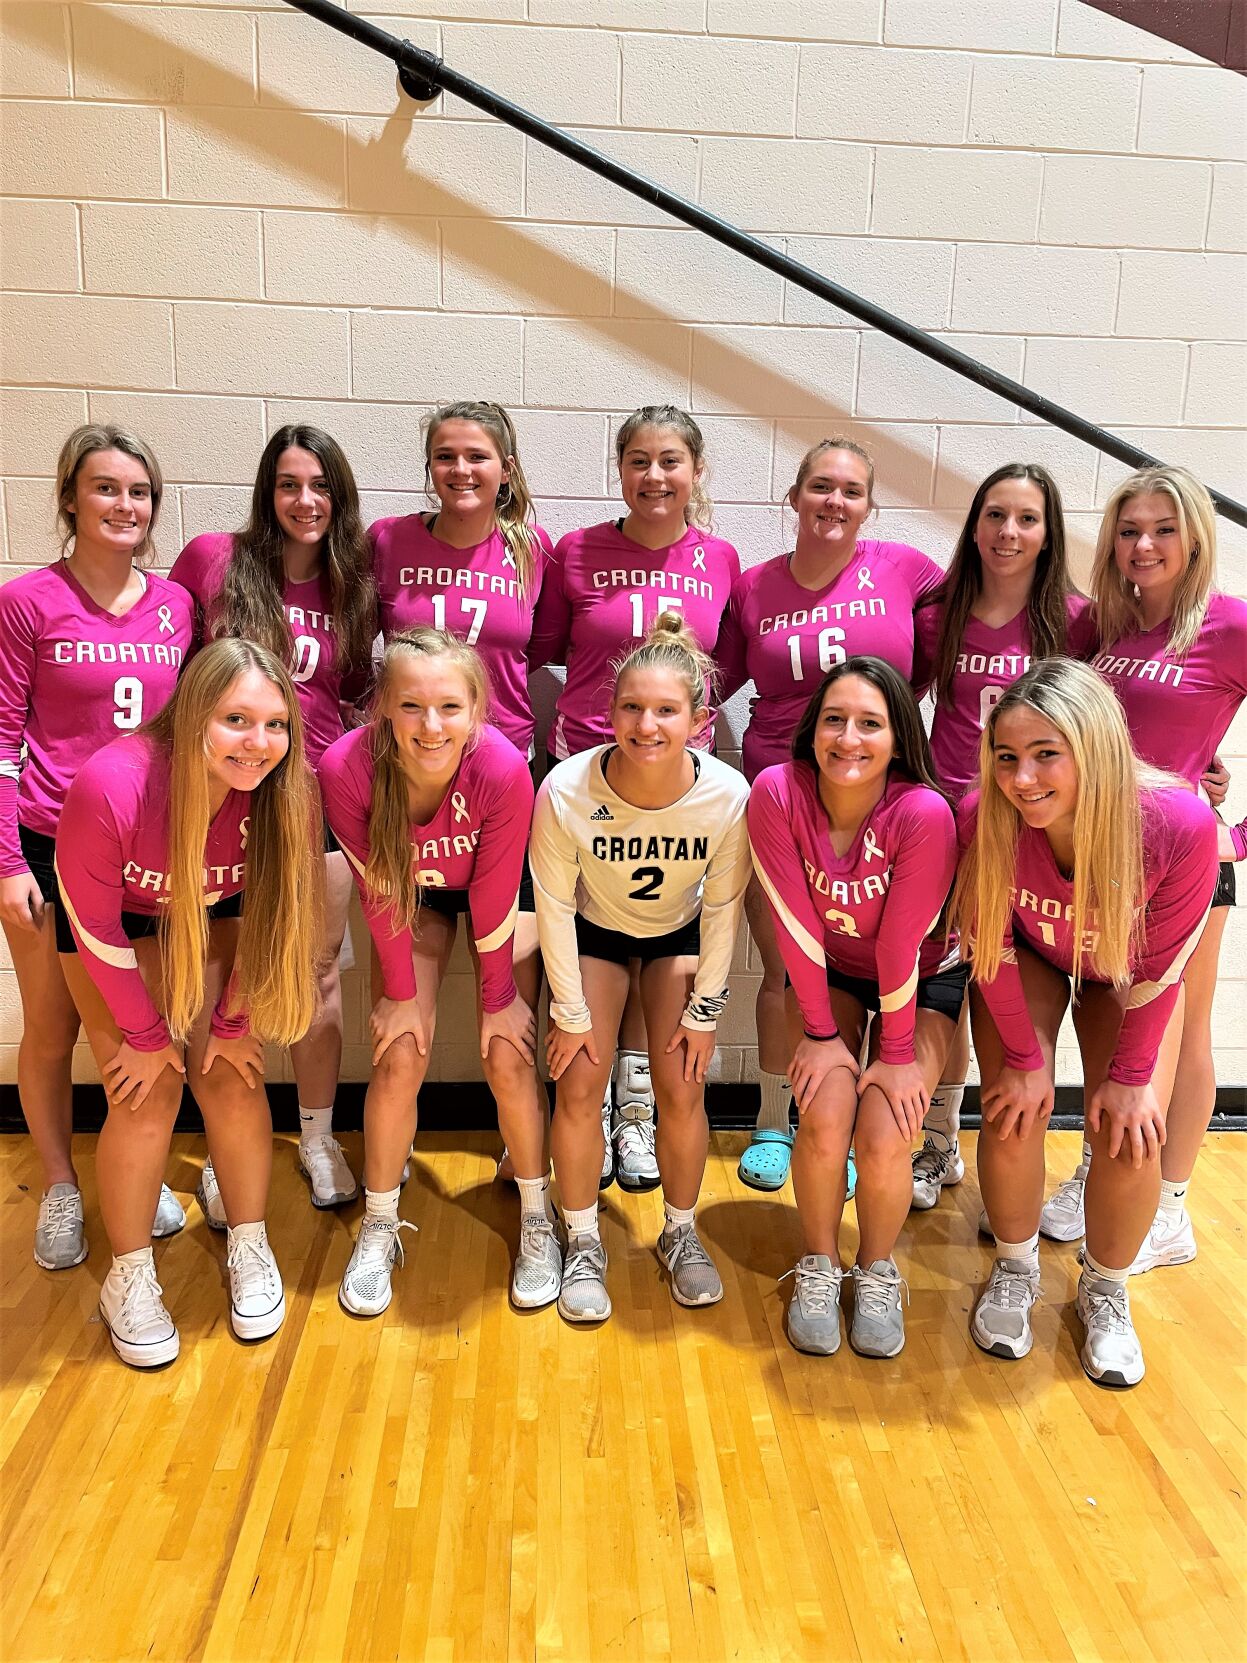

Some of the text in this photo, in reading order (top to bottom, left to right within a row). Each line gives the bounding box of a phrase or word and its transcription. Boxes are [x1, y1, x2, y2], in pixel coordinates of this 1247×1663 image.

[592, 569, 713, 601] CROATAN
[431, 594, 488, 646] 17
[759, 598, 886, 635] CROATAN
[54, 641, 182, 668] CROATAN
[788, 627, 847, 681] 16
[113, 676, 144, 729] 9
[592, 836, 709, 862] CROATAN
[628, 866, 665, 901] 2
